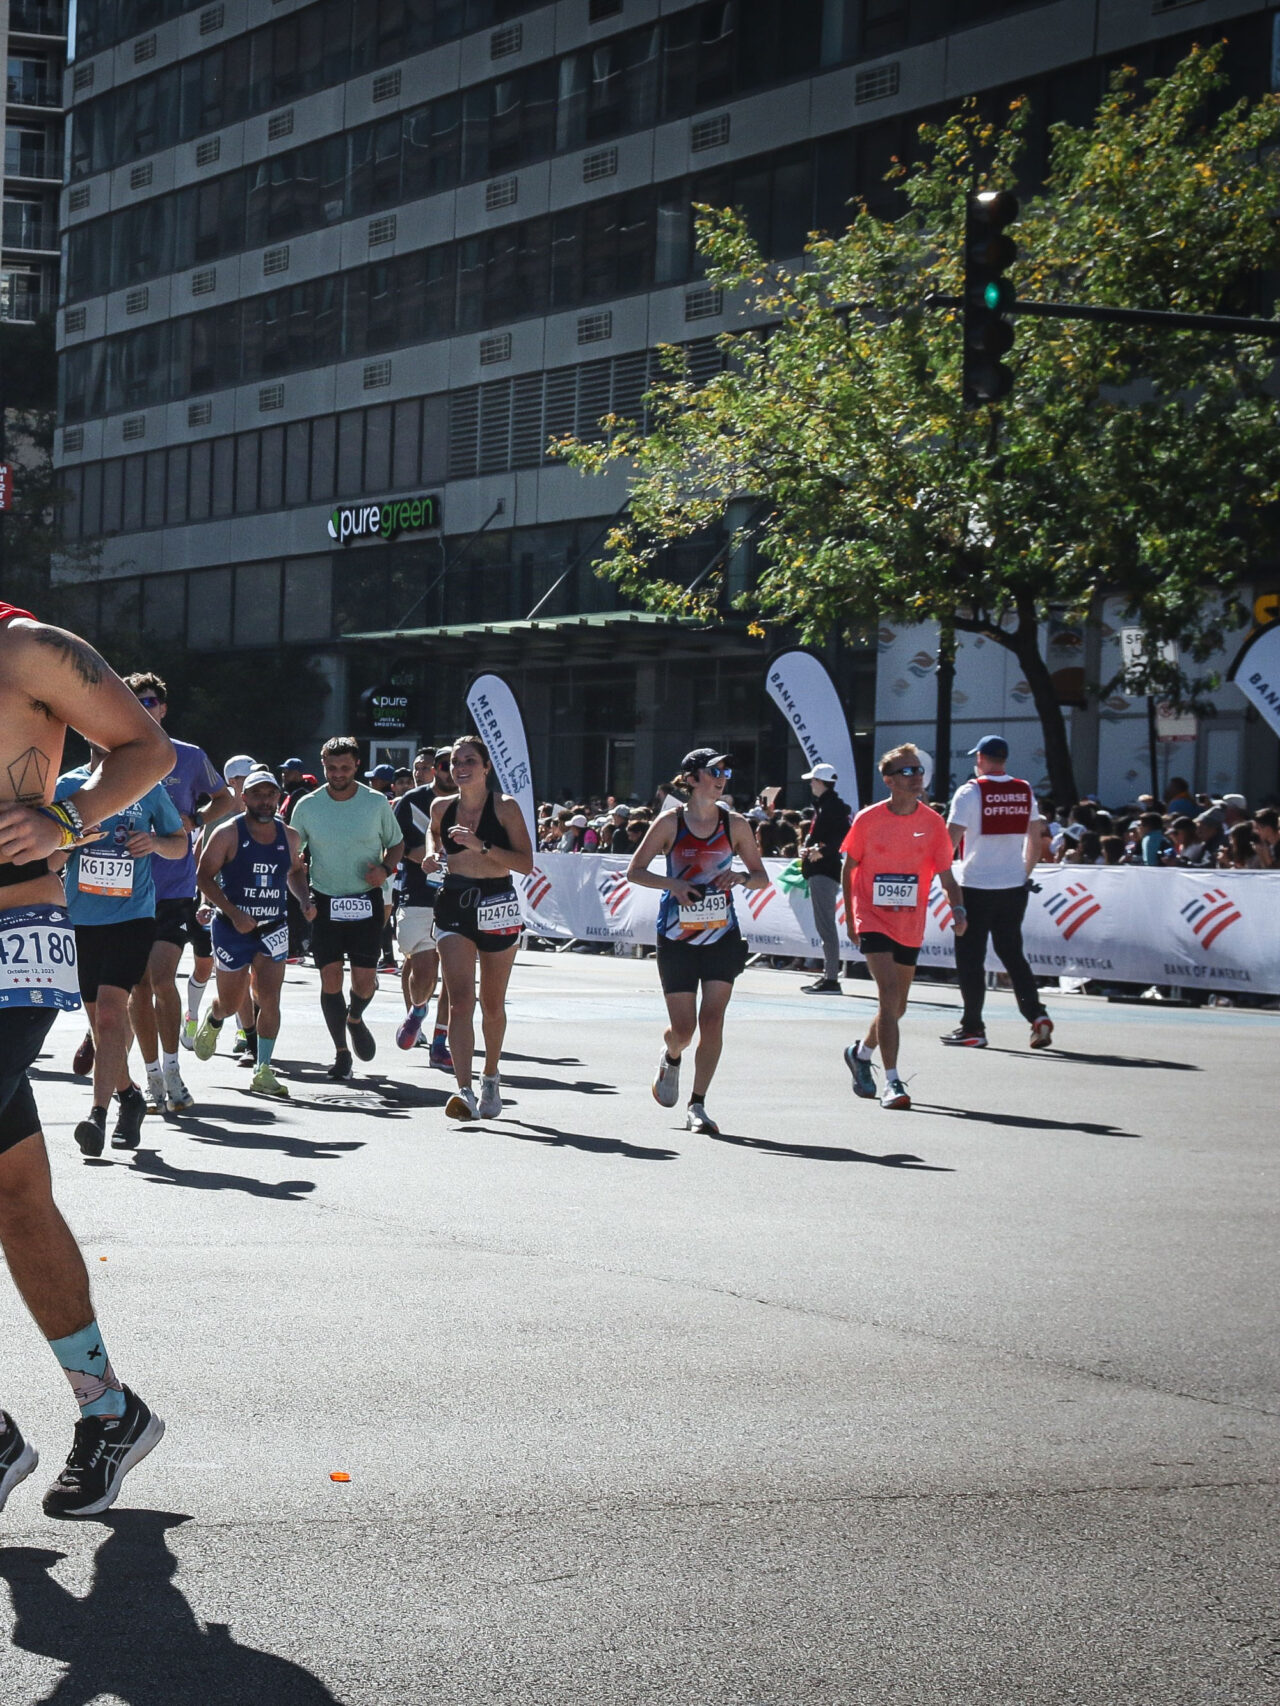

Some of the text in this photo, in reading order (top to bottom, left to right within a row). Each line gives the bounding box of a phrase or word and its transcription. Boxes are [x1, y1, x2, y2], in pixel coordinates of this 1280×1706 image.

[380, 696, 408, 708] pure
[770, 672, 796, 712] BANK
[792, 713, 807, 732] OF
[477, 694, 512, 768] MERRILL
[985, 793, 1028, 803] COURSE
[984, 806, 1029, 816] OFFICIAL
[81, 858, 132, 877] K61379
[253, 863, 278, 874] EDY
[243, 887, 280, 899] TE AMO
[878, 884, 913, 897] D9467
[332, 901, 371, 911] G40536
[479, 903, 520, 921] H24762
[216, 946, 234, 963] EDY
[1164, 963, 1252, 983] BANK OF AMERICA
